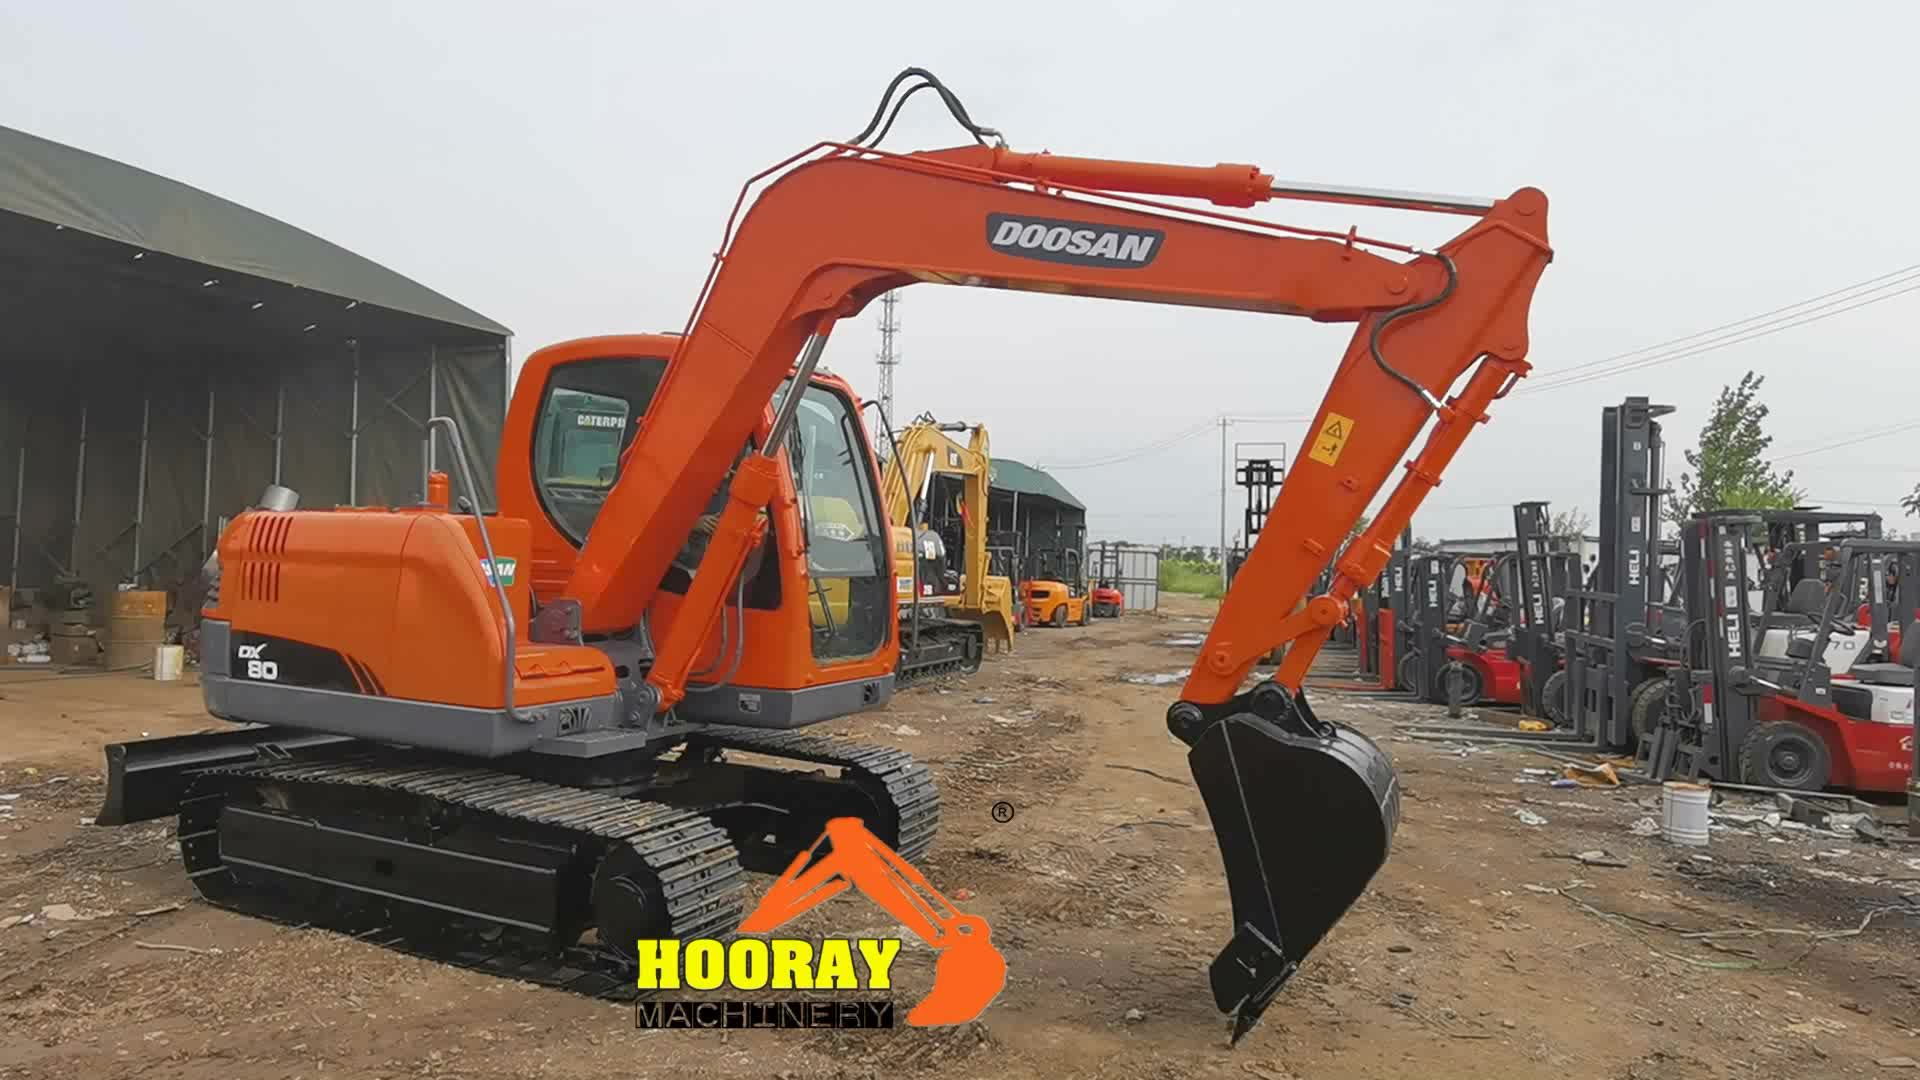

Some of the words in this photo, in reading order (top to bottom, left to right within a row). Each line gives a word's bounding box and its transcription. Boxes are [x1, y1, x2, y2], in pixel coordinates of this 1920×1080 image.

[992, 221, 1154, 262] DOOSAN
[1628, 550, 1641, 585] HELI
[238, 643, 268, 660] DX
[1726, 613, 1742, 658] HELI
[247, 660, 278, 680] 80
